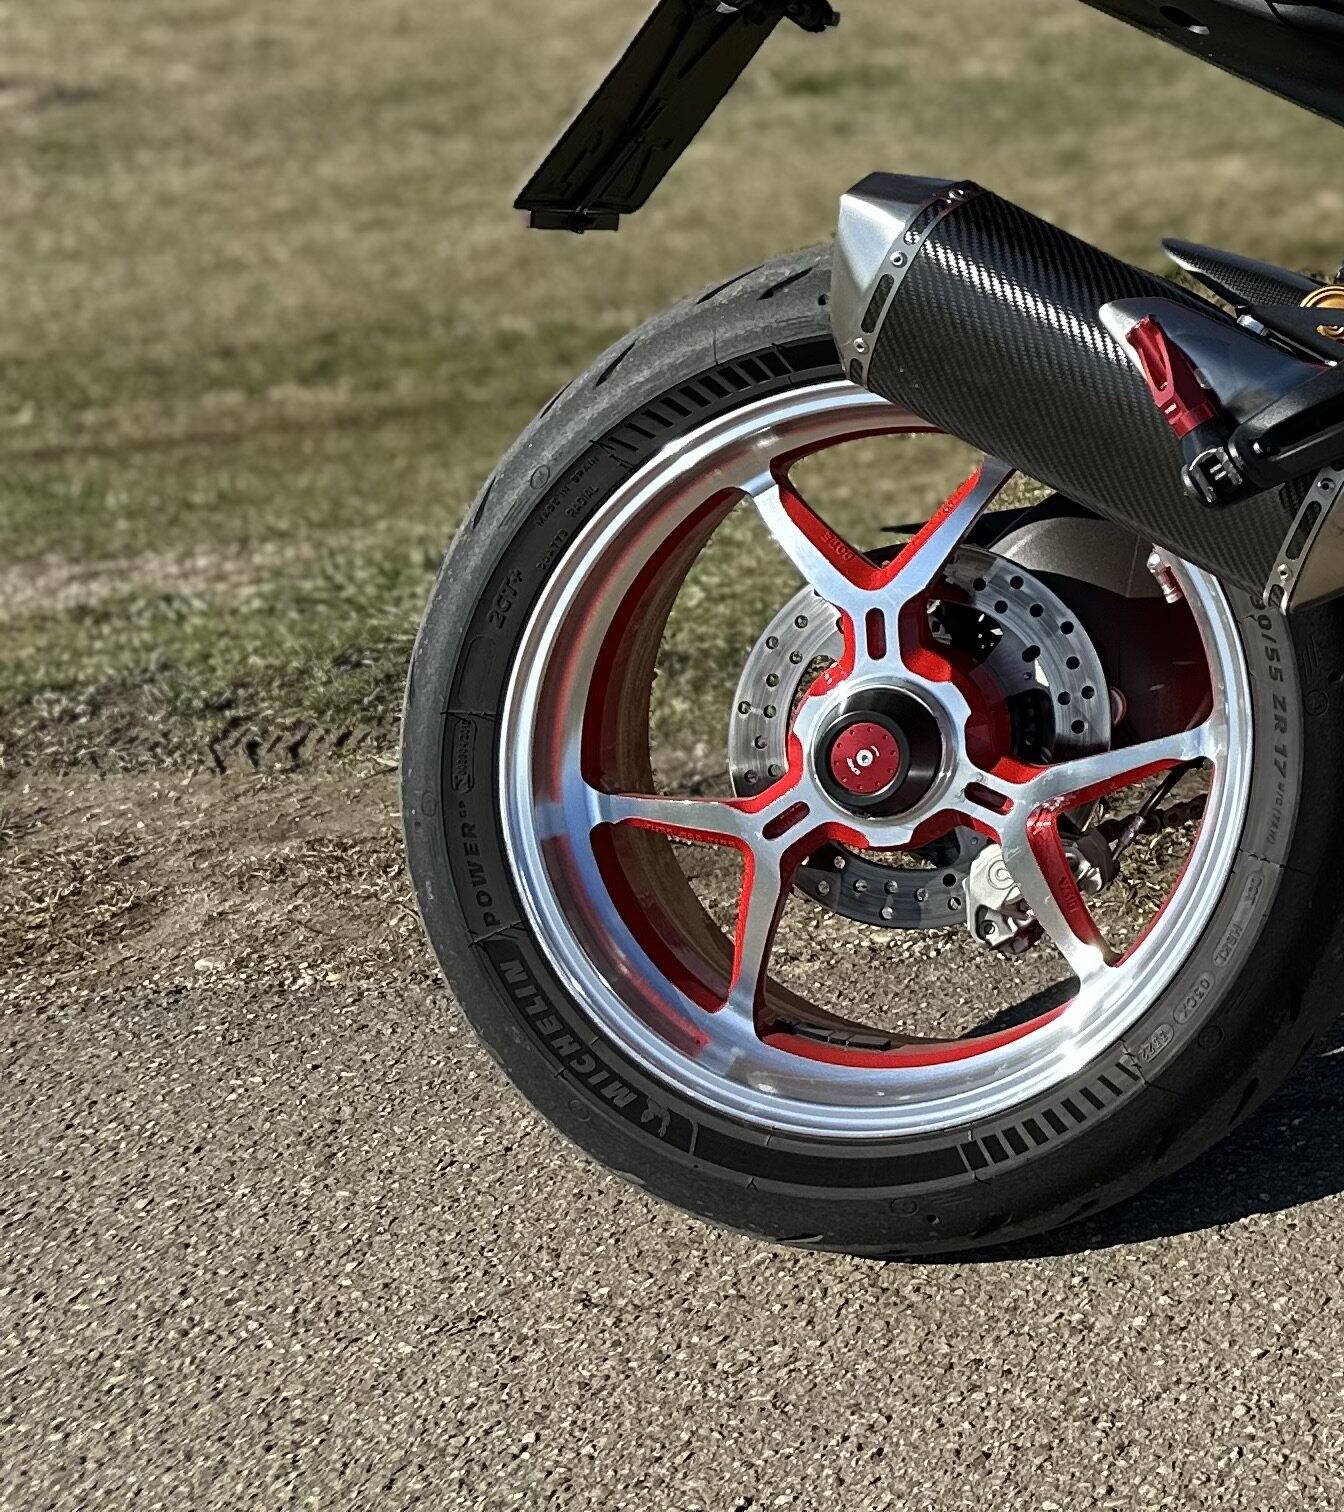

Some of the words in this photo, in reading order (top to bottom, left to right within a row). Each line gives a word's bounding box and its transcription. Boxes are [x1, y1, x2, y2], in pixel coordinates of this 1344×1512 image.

[1250, 592, 1284, 683] 90/55
[1273, 692, 1288, 735] ZR
[1273, 744, 1288, 779] 17
[461, 822, 500, 928] POWER
[500, 959, 638, 1109] MICHELIN
